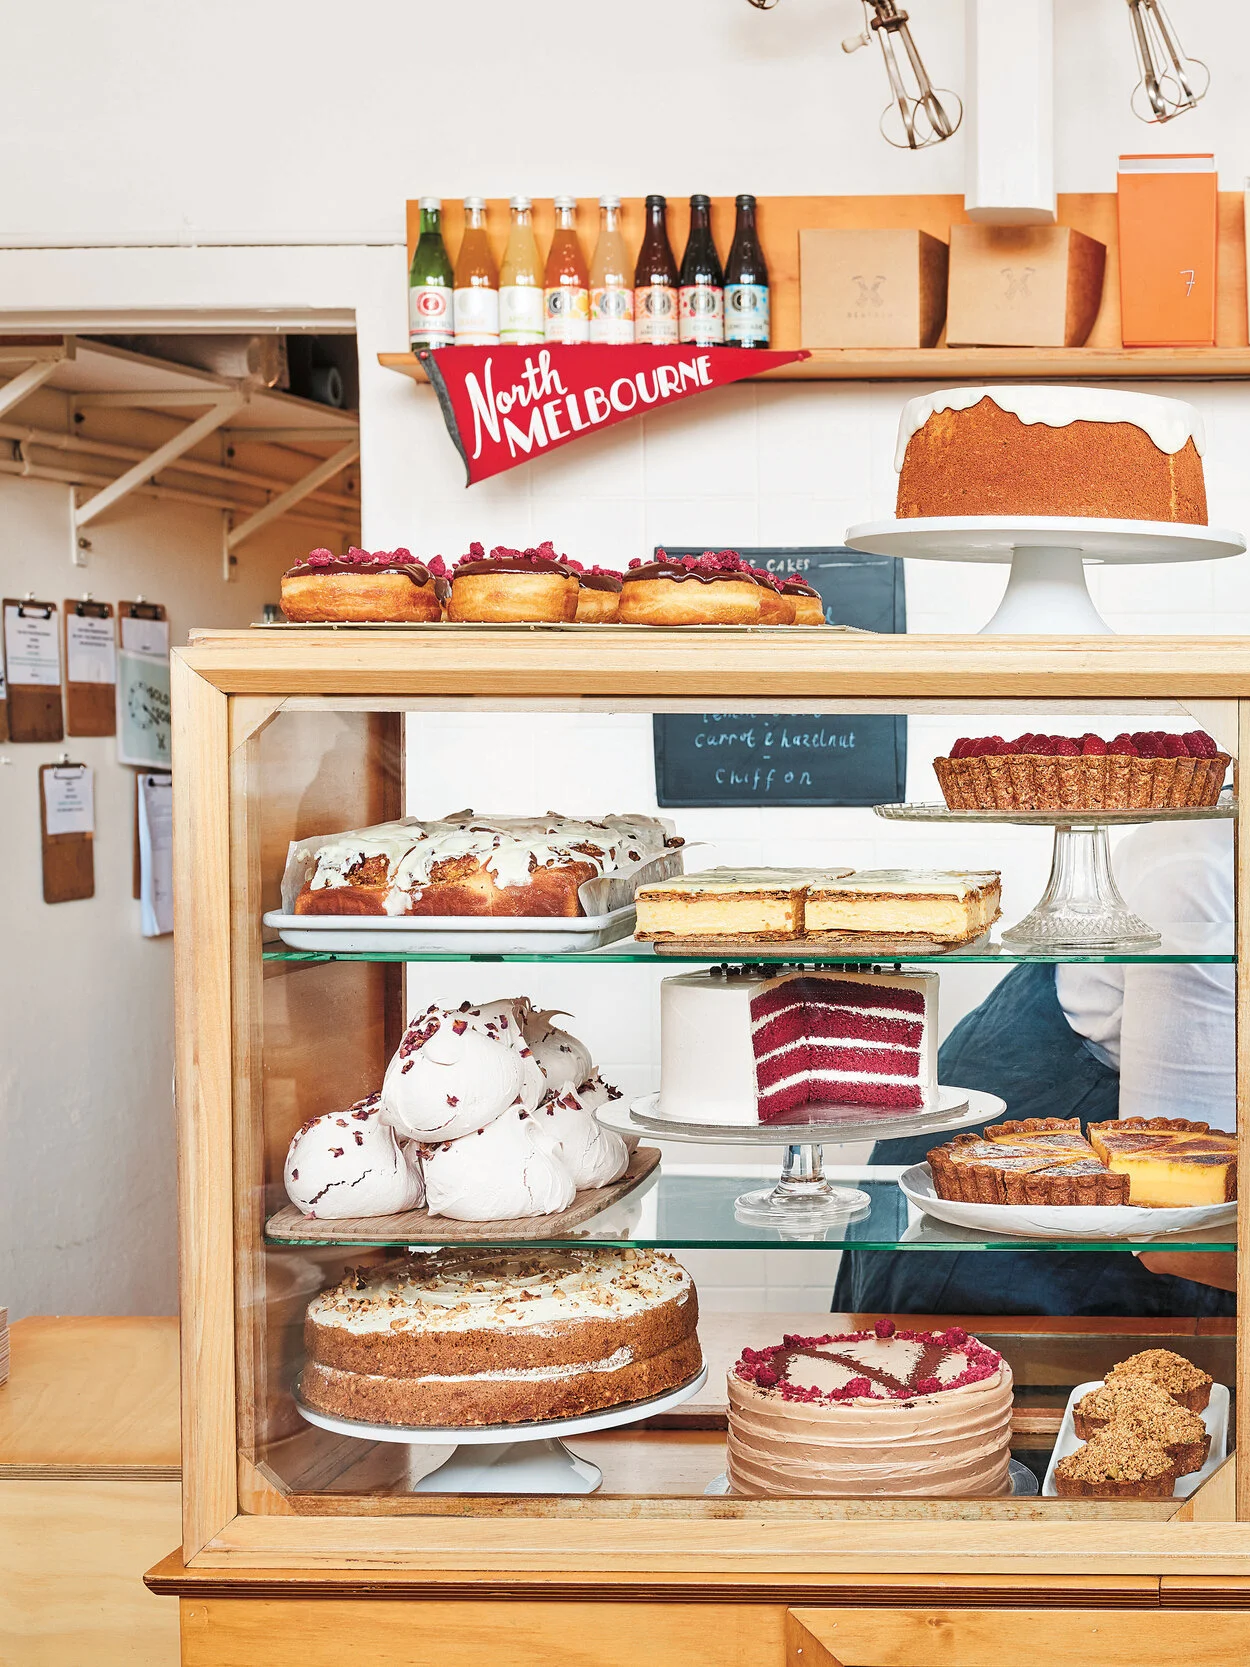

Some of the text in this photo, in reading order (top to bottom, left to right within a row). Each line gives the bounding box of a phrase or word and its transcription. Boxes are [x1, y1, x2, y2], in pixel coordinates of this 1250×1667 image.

[464, 349, 568, 460] North
[503, 354, 714, 458] MELBOURNE
[766, 558, 812, 573] CAKES
[780, 728, 857, 748] hazelnut
